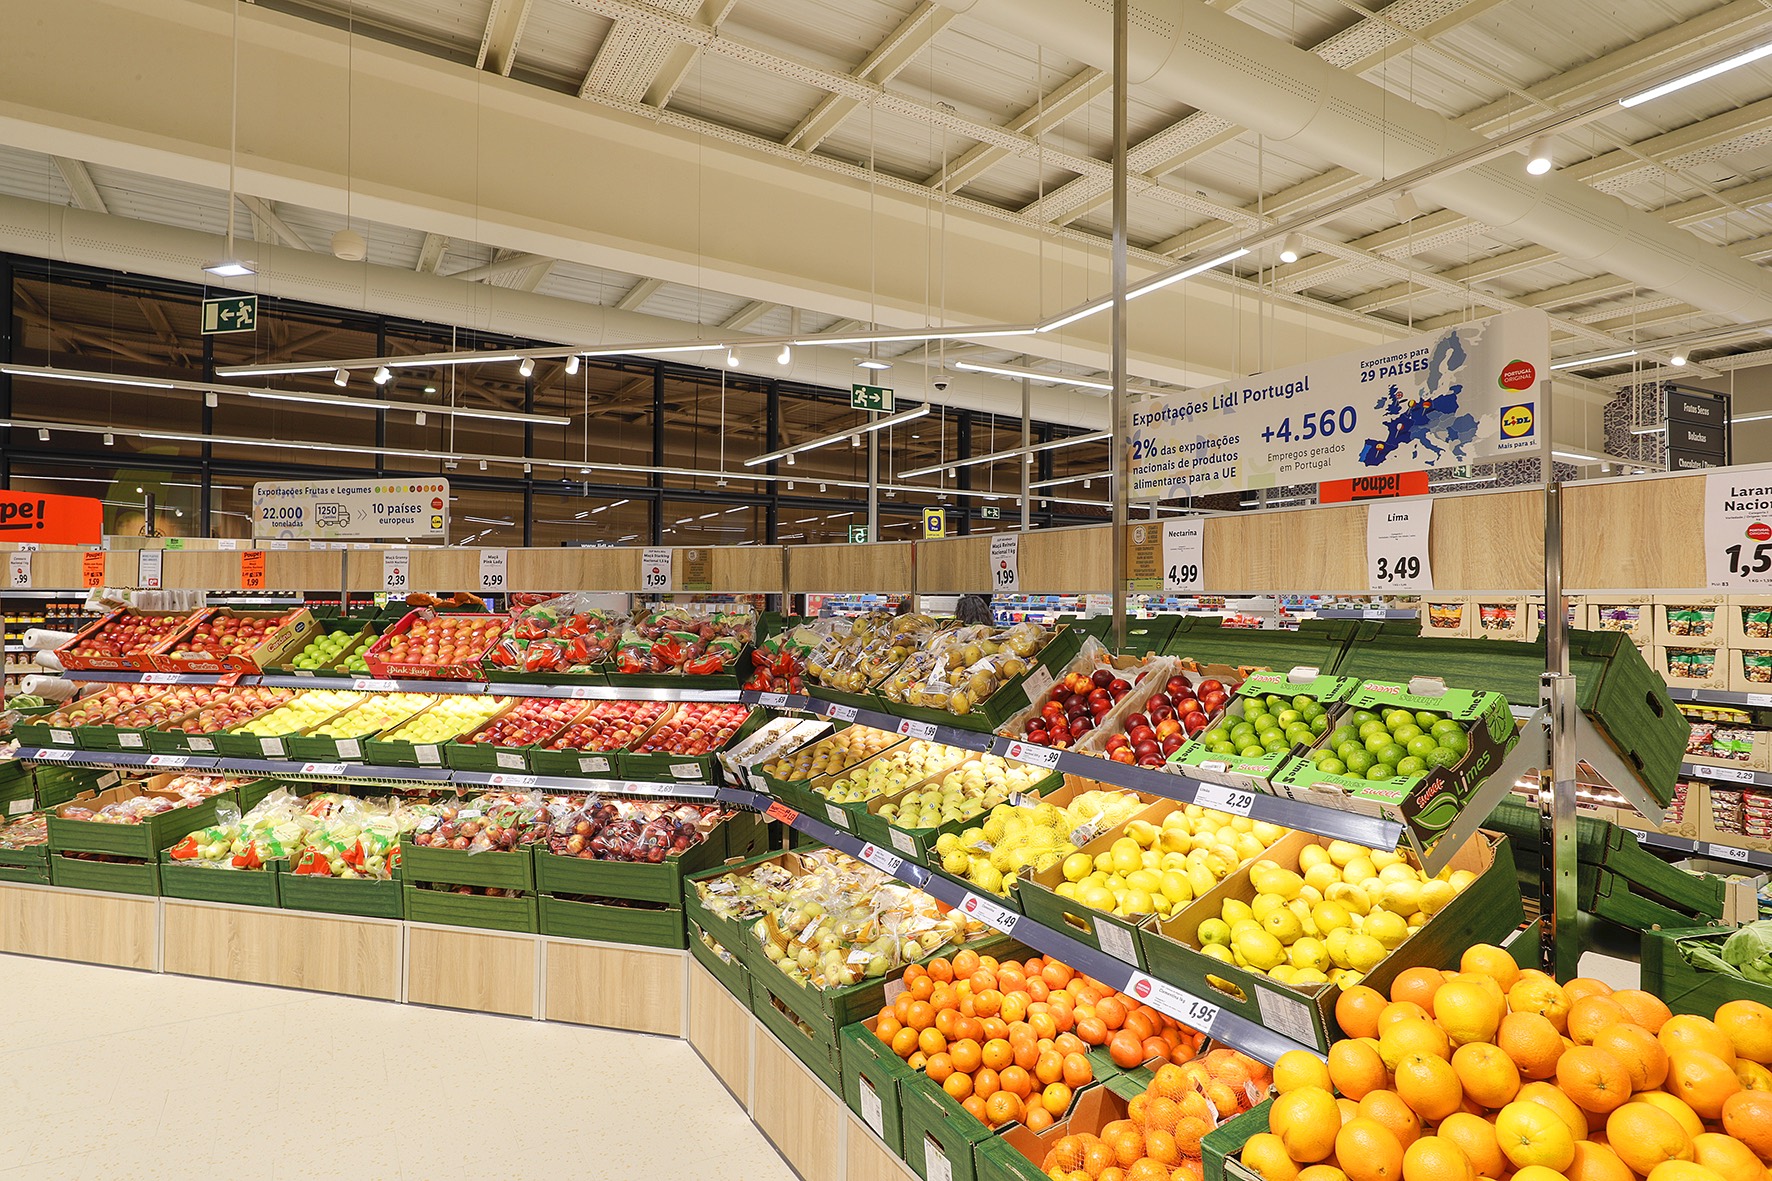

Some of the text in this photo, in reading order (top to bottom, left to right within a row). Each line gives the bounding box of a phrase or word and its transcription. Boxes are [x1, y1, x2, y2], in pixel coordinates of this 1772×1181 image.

[1360, 348, 1429, 368] Exportamos para
[1361, 357, 1429, 383] 29 PAÍSES
[1504, 369, 1532, 378] PORTUGAL
[1504, 374, 1532, 383] ORIGINAL
[1133, 376, 1310, 428] Exportações Lidl Portugal
[1261, 405, 1359, 444] +4.560
[1133, 434, 1241, 460] 2% das exportações
[1268, 444, 1346, 463] Empregos gerados
[1133, 451, 1239, 476] nacionais de produtos
[1280, 458, 1332, 473] em Portugal
[1133, 466, 1236, 490] alimentares para a UE
[258, 487, 303, 498] Exportações
[305, 486, 329, 495] Frutas
[337, 486, 372, 496] Legumes
[263, 506, 303, 520] 22.000
[318, 506, 337, 515] 1250
[372, 503, 422, 516] 10 países
[272, 520, 304, 528] toneladas
[379, 518, 415, 526] europeus
[1387, 513, 1409, 522] Lima
[1168, 529, 1197, 537] Nectarina
[1168, 565, 1198, 586] 4,99
[1376, 556, 1421, 582] 3,49
[387, 575, 405, 586] 2,39
[483, 575, 503, 587] 2,99
[646, 574, 667, 587] 1,99
[996, 569, 1014, 587] 1,99
[387, 664, 431, 677] Pink Lady
[1453, 750, 1491, 796] Limes
[1736, 772, 1753, 780] 2,29
[1226, 792, 1252, 809] 2,29
[1729, 850, 1746, 858] 6,49
[996, 912, 1016, 928] 2,49
[1188, 1002, 1216, 1023] 1,95
